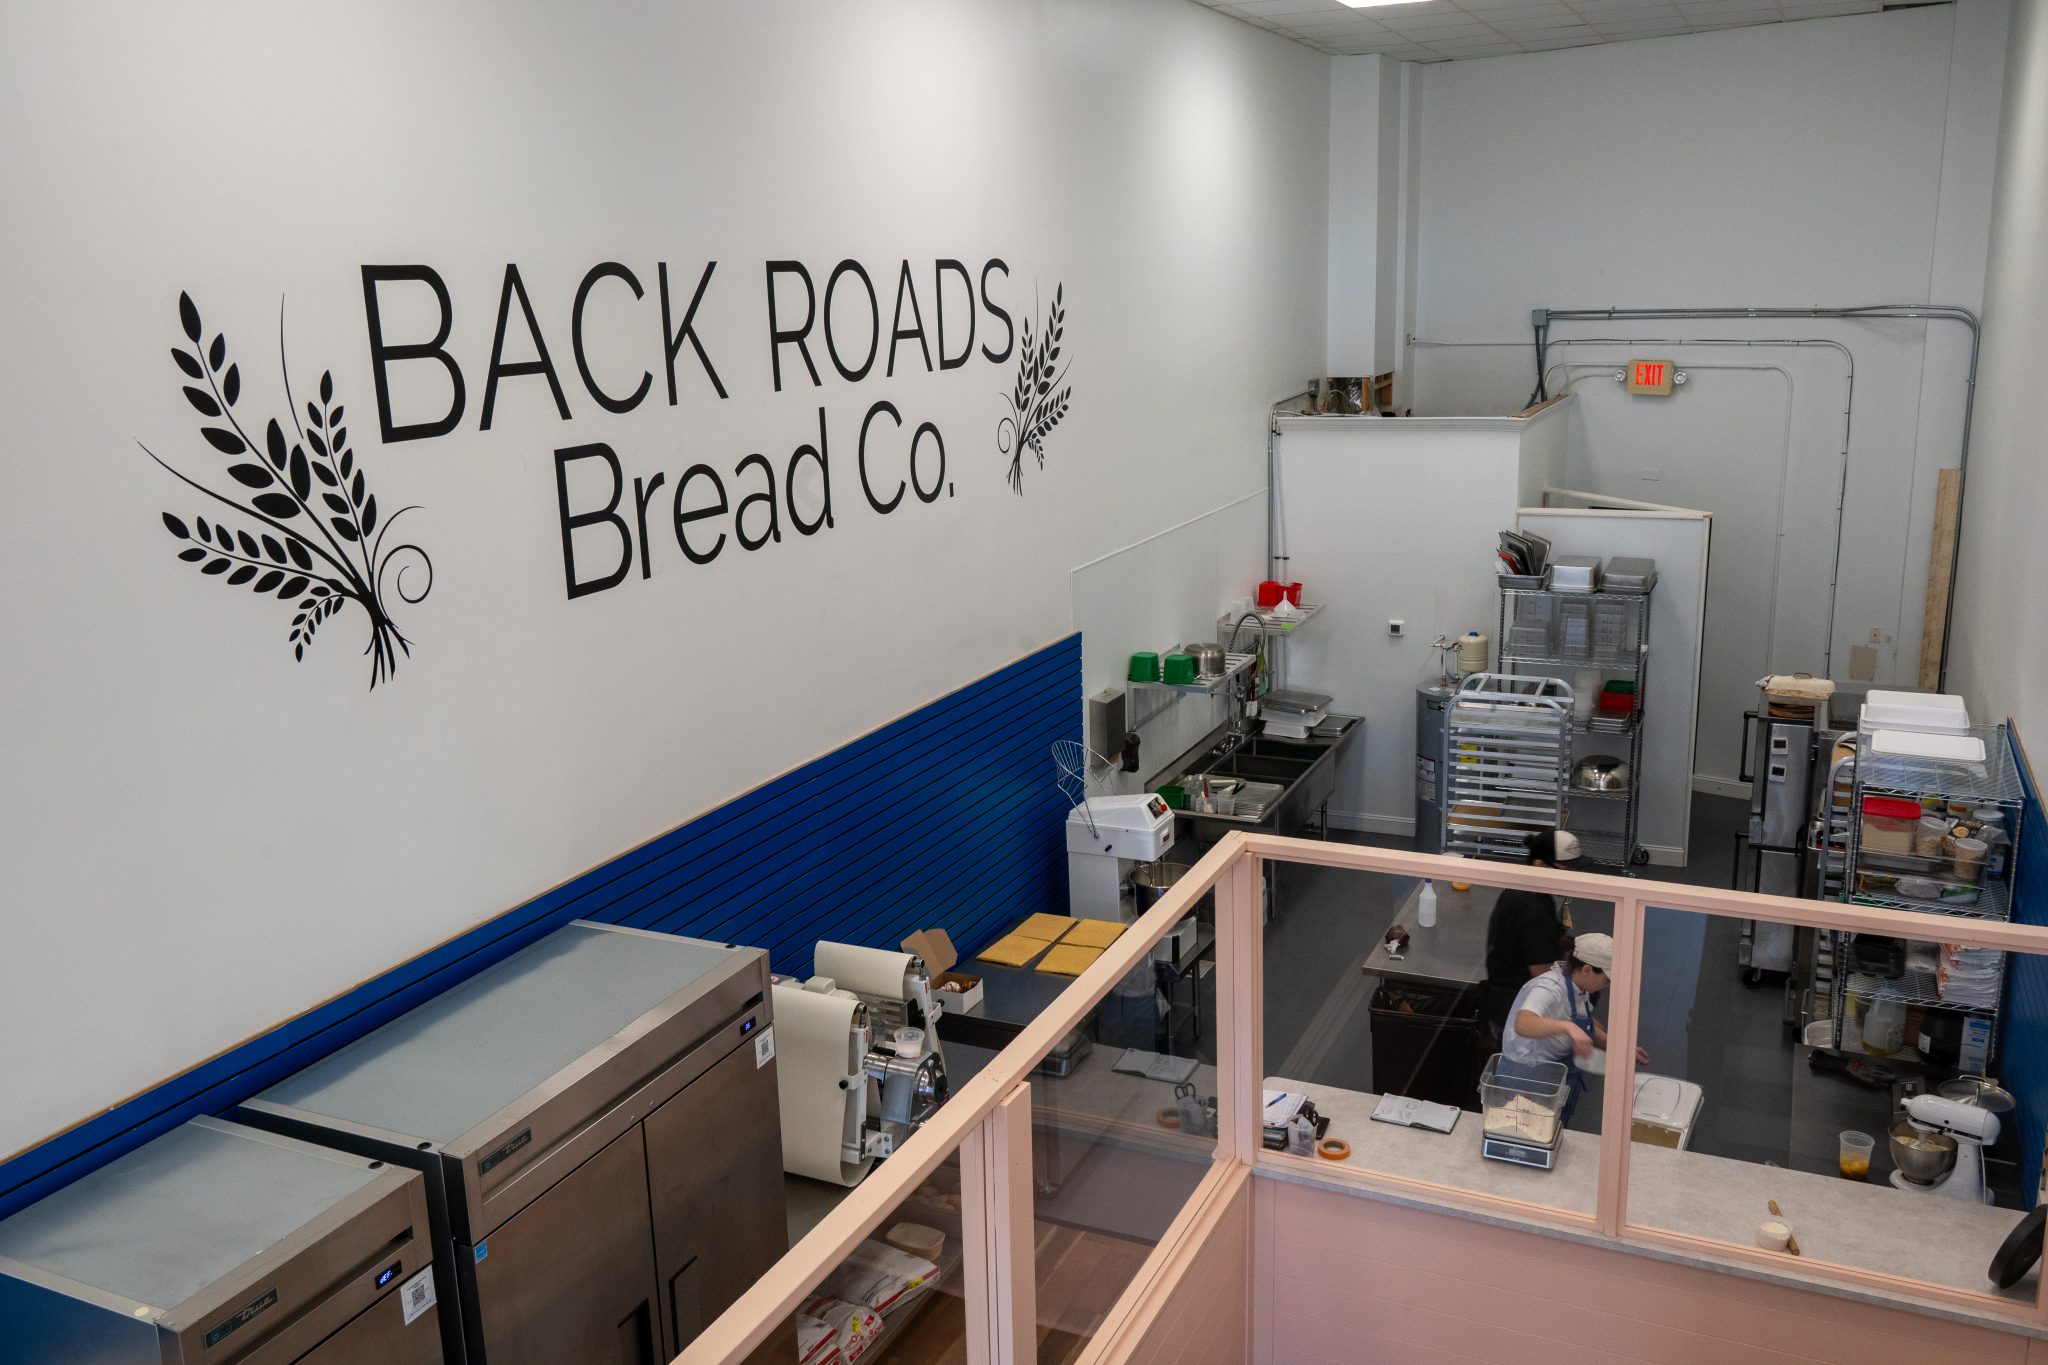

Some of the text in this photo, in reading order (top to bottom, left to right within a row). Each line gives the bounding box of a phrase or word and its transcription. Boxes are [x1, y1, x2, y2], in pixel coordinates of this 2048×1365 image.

[361, 258, 1014, 445] BACK ROADS
[1635, 363, 1665, 386] EXIT
[554, 400, 954, 600] Bread Co.
